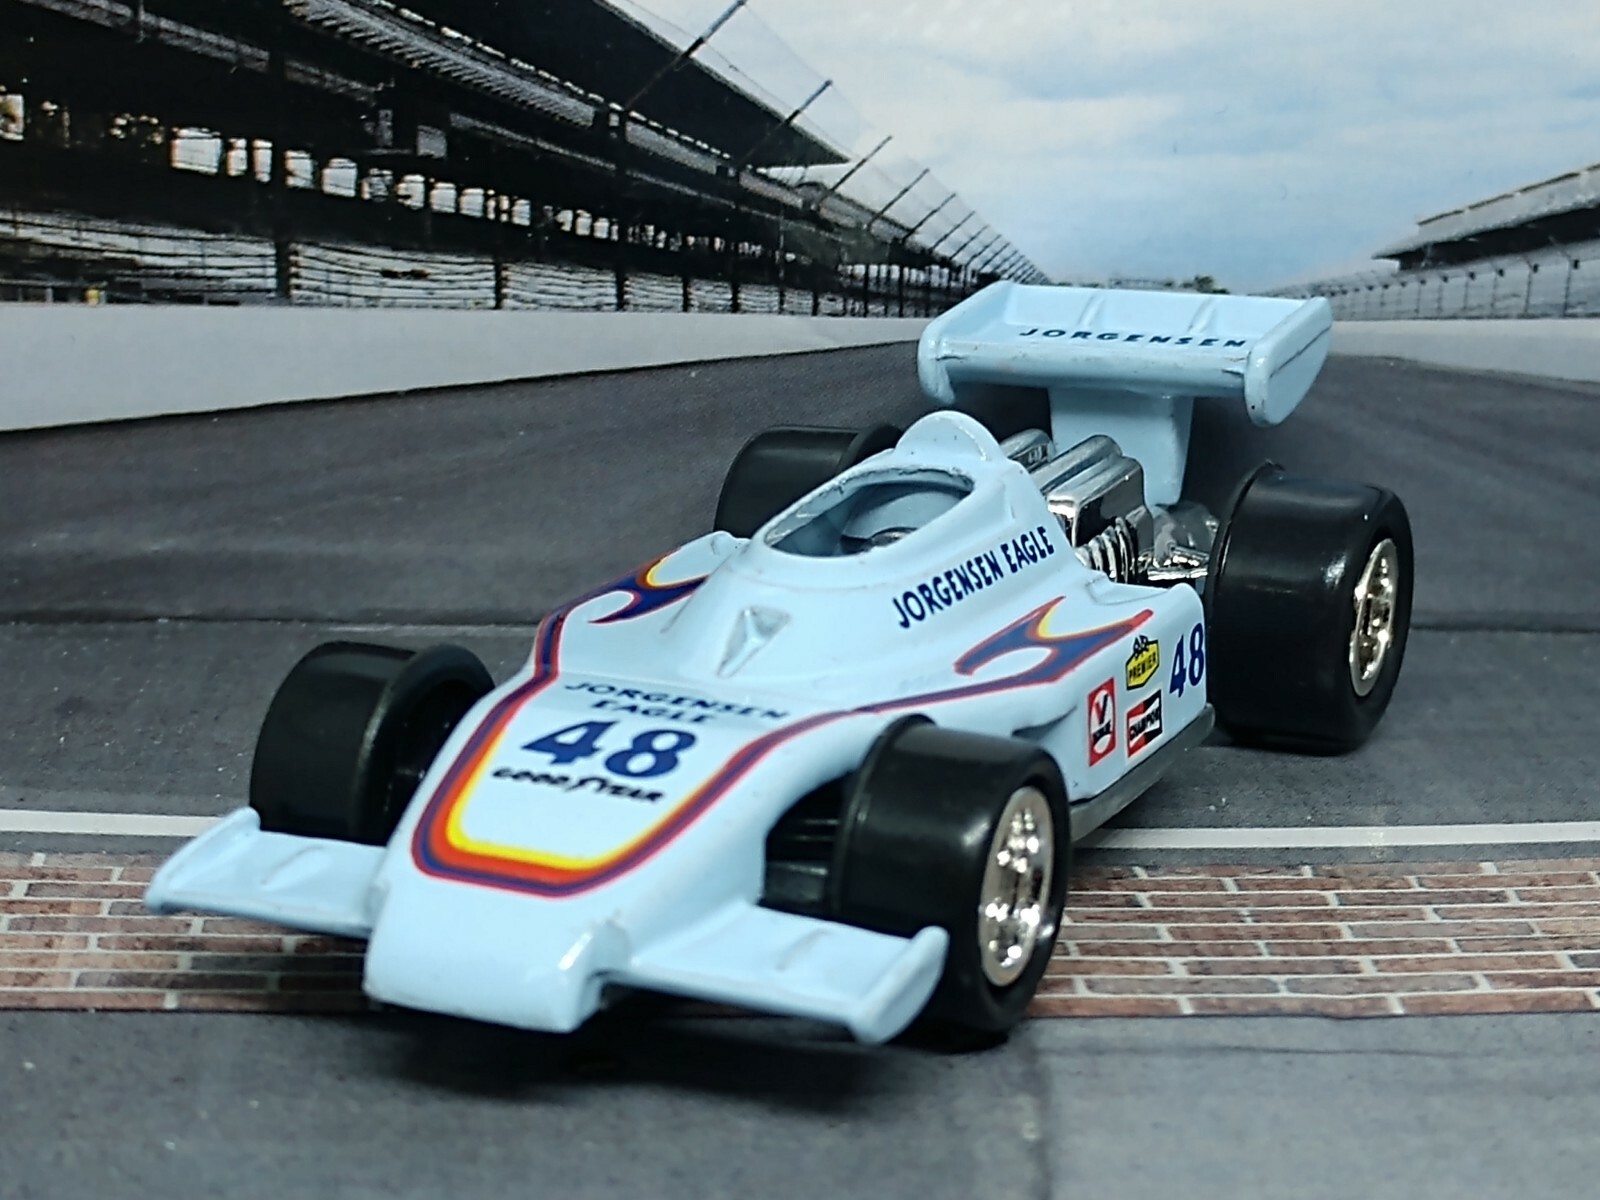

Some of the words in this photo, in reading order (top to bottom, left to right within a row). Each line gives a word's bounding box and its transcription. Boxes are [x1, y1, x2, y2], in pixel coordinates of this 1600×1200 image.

[1019, 328, 1247, 348] JORGENSEN
[892, 550, 1004, 629] JORGENSEN
[1000, 525, 1055, 574] EAGLE
[1128, 651, 1157, 679] PREMIER
[1169, 622, 1205, 699] 48
[564, 682, 790, 719] JORGENSEN
[591, 699, 715, 724] EAGLE
[520, 720, 698, 779] 48
[492, 767, 664, 803] GOODYEAR
